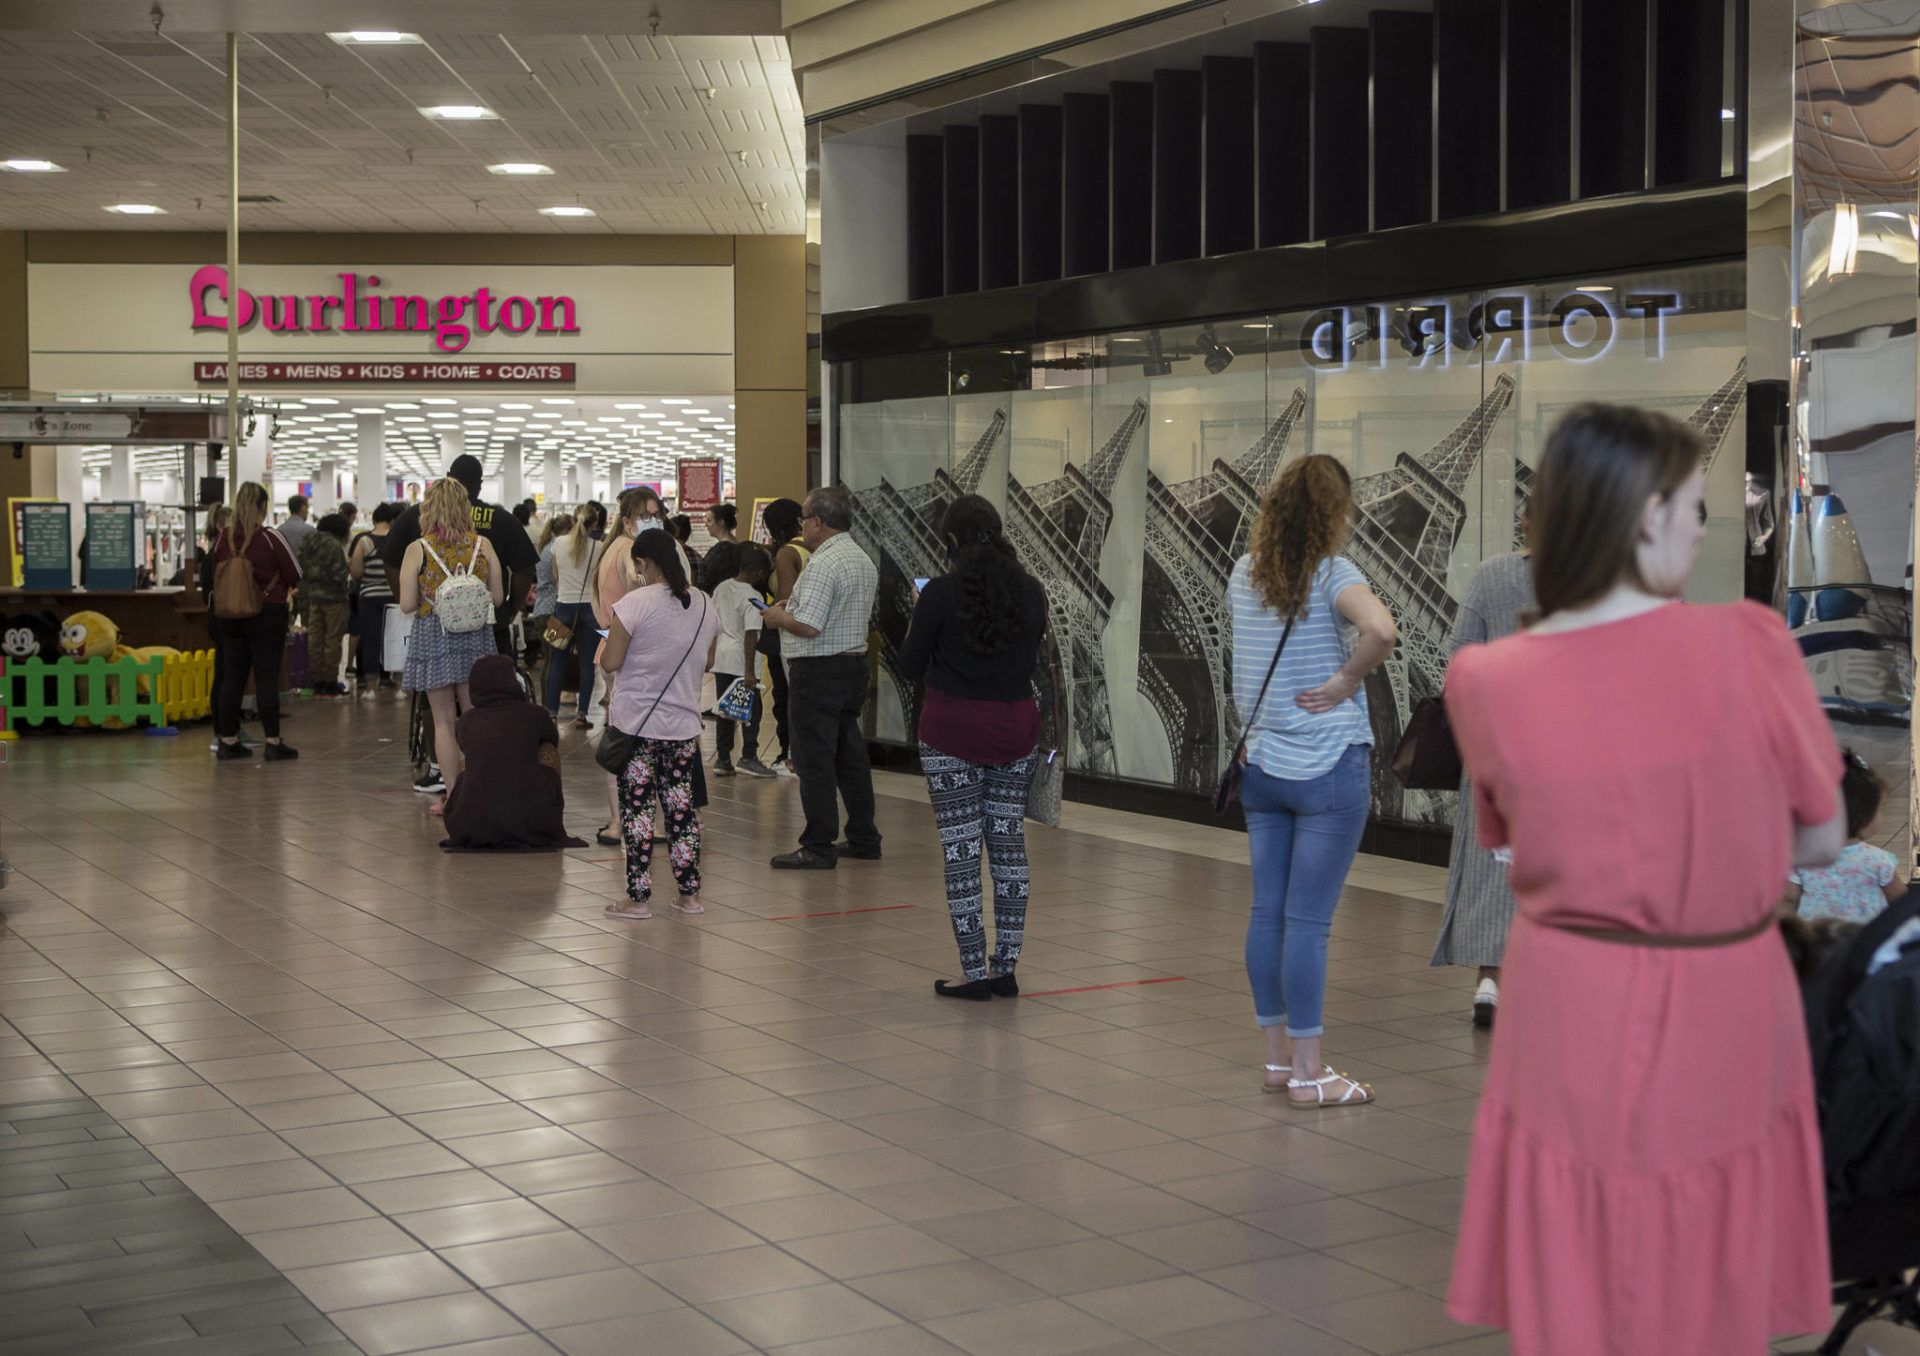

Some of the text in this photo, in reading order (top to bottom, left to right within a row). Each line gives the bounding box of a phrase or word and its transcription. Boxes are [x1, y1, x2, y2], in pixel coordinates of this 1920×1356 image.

[189, 264, 581, 351] Burlington
[200, 365, 562, 379] LAIES MENS KIDS HOME COATS
[63, 421, 92, 431] Zone
